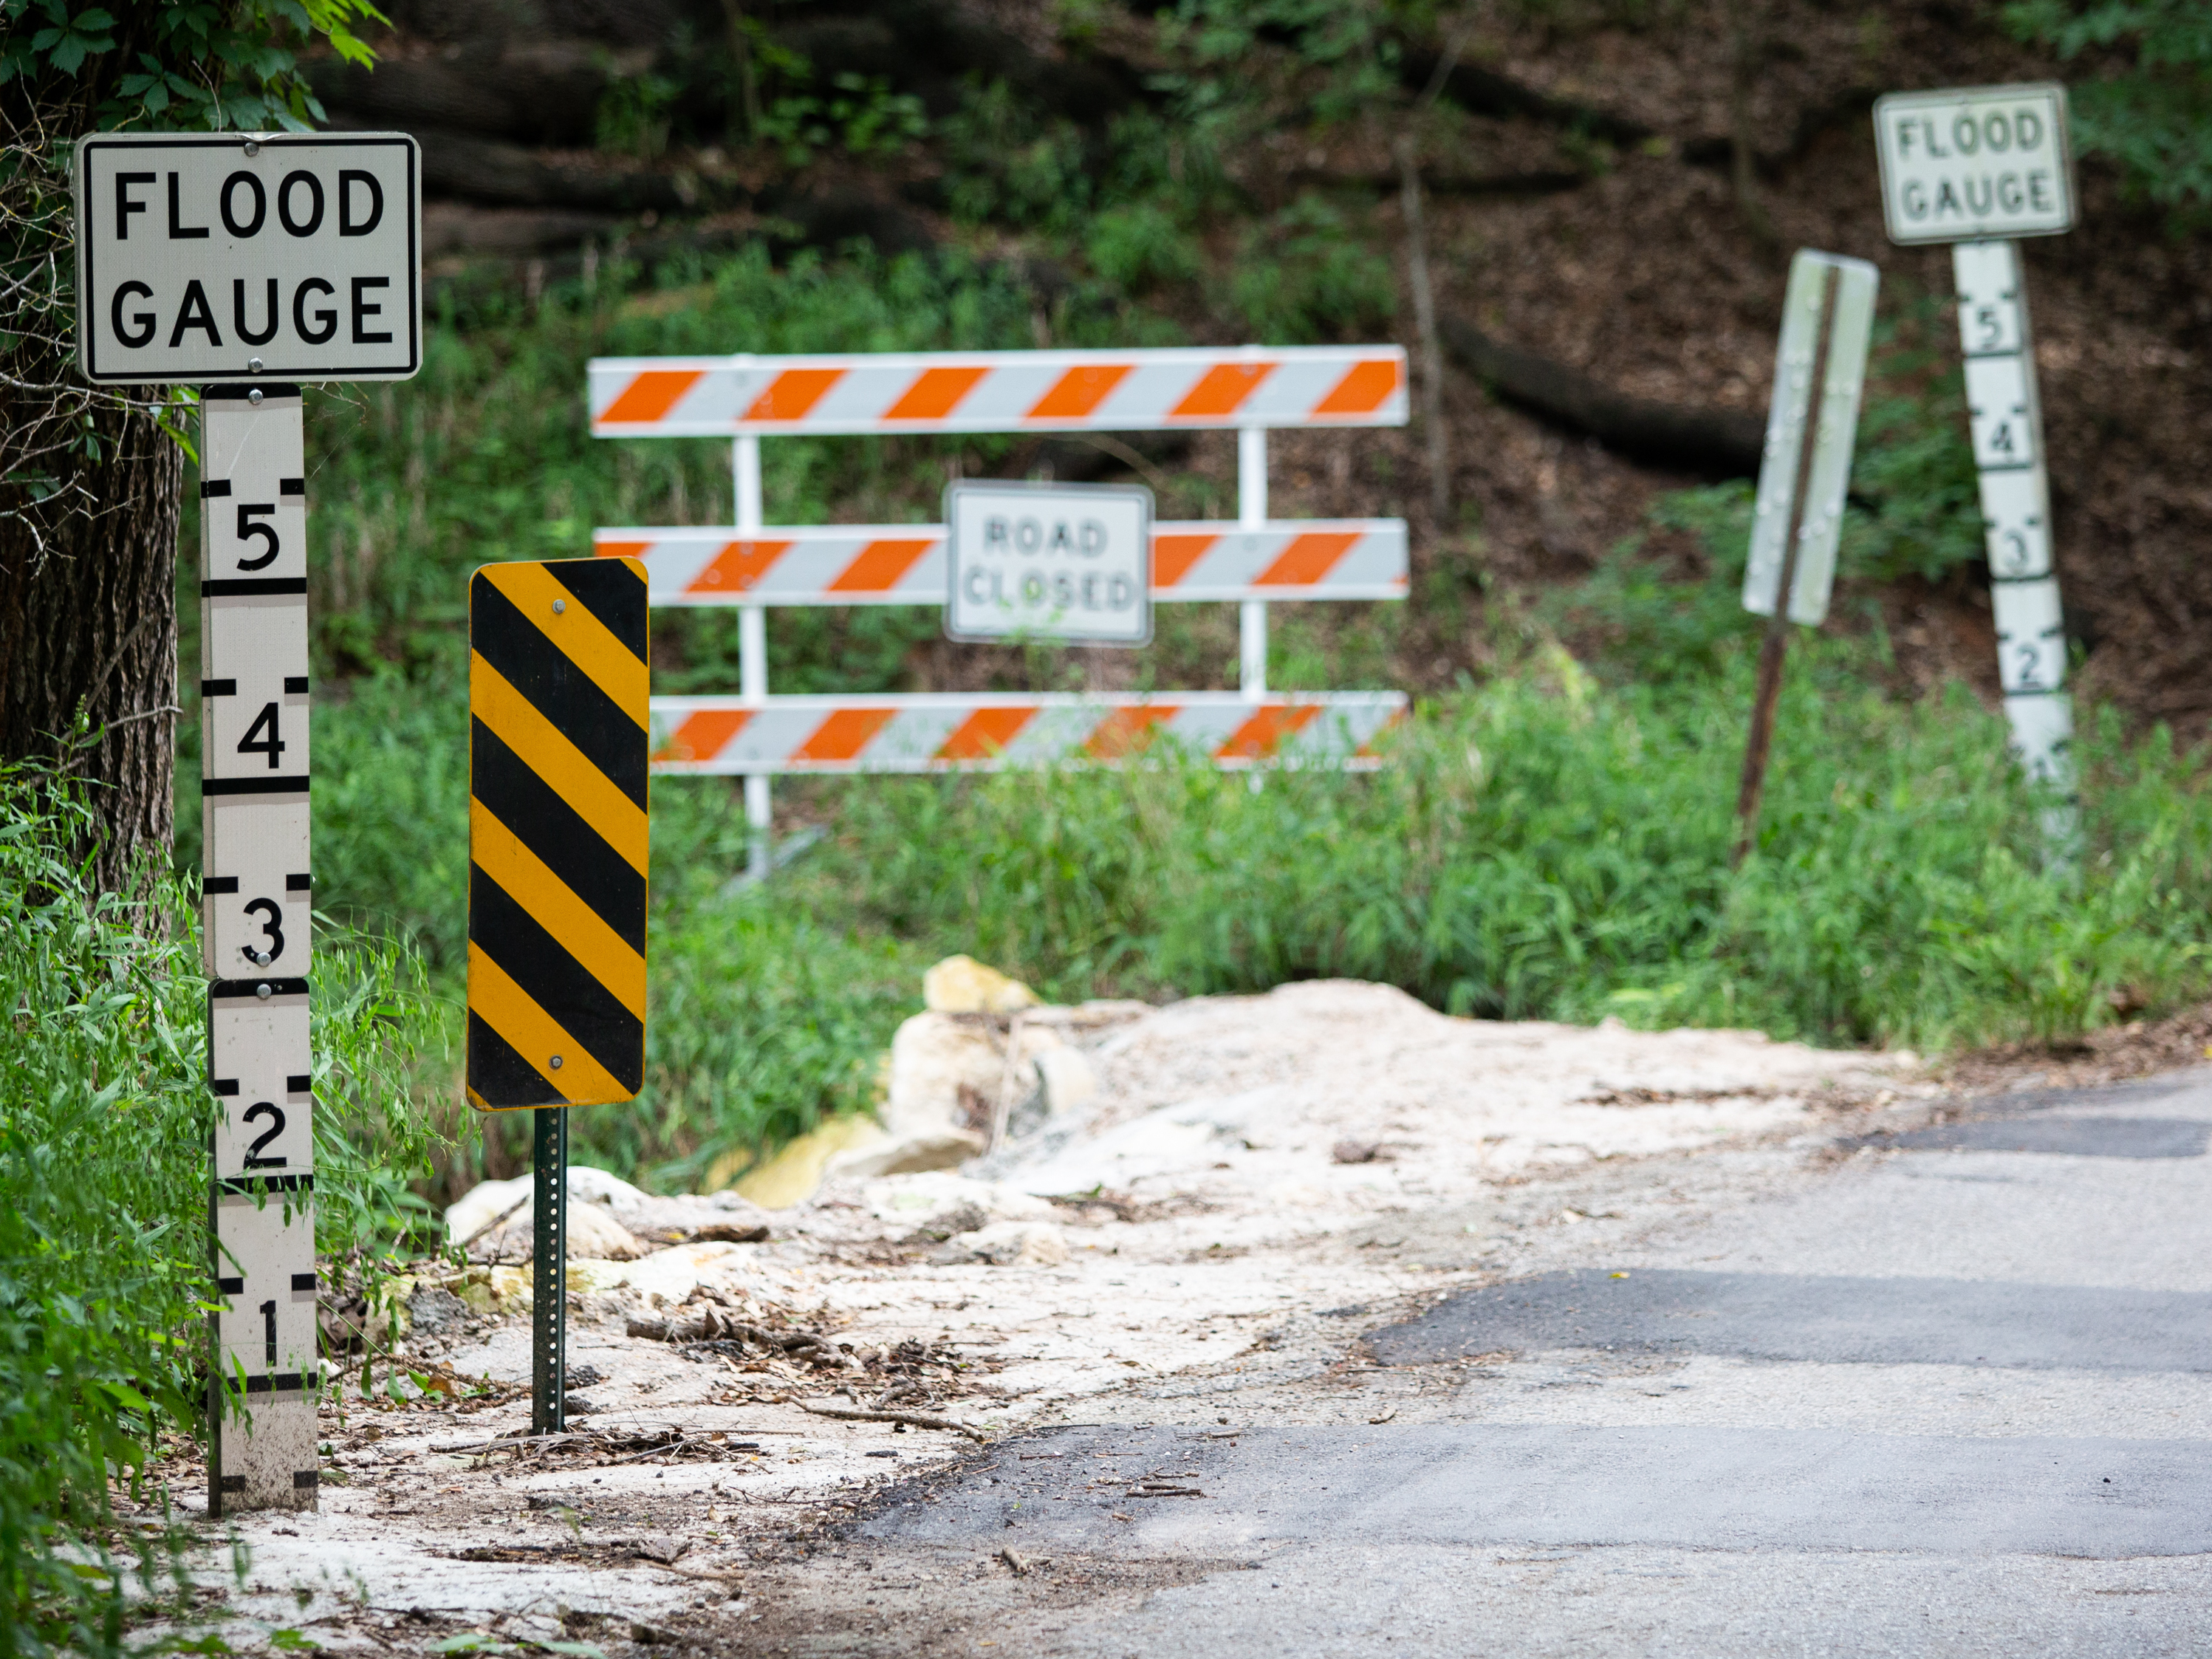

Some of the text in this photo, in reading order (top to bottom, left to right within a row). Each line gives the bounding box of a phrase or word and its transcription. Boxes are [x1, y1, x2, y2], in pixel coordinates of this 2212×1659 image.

[1895, 109, 2044, 163] FLOOD
[115, 169, 384, 240] FLOOD
[1900, 169, 2052, 222] GAUGE
[111, 277, 393, 349] GAUGE
[236, 504, 280, 572] 5
[984, 516, 1109, 557] ROAD
[962, 566, 1137, 612] CLOSED
[237, 702, 285, 769] 4
[241, 897, 285, 965] 3
[242, 1101, 287, 1170] 2
[259, 1299, 278, 1367] 1
